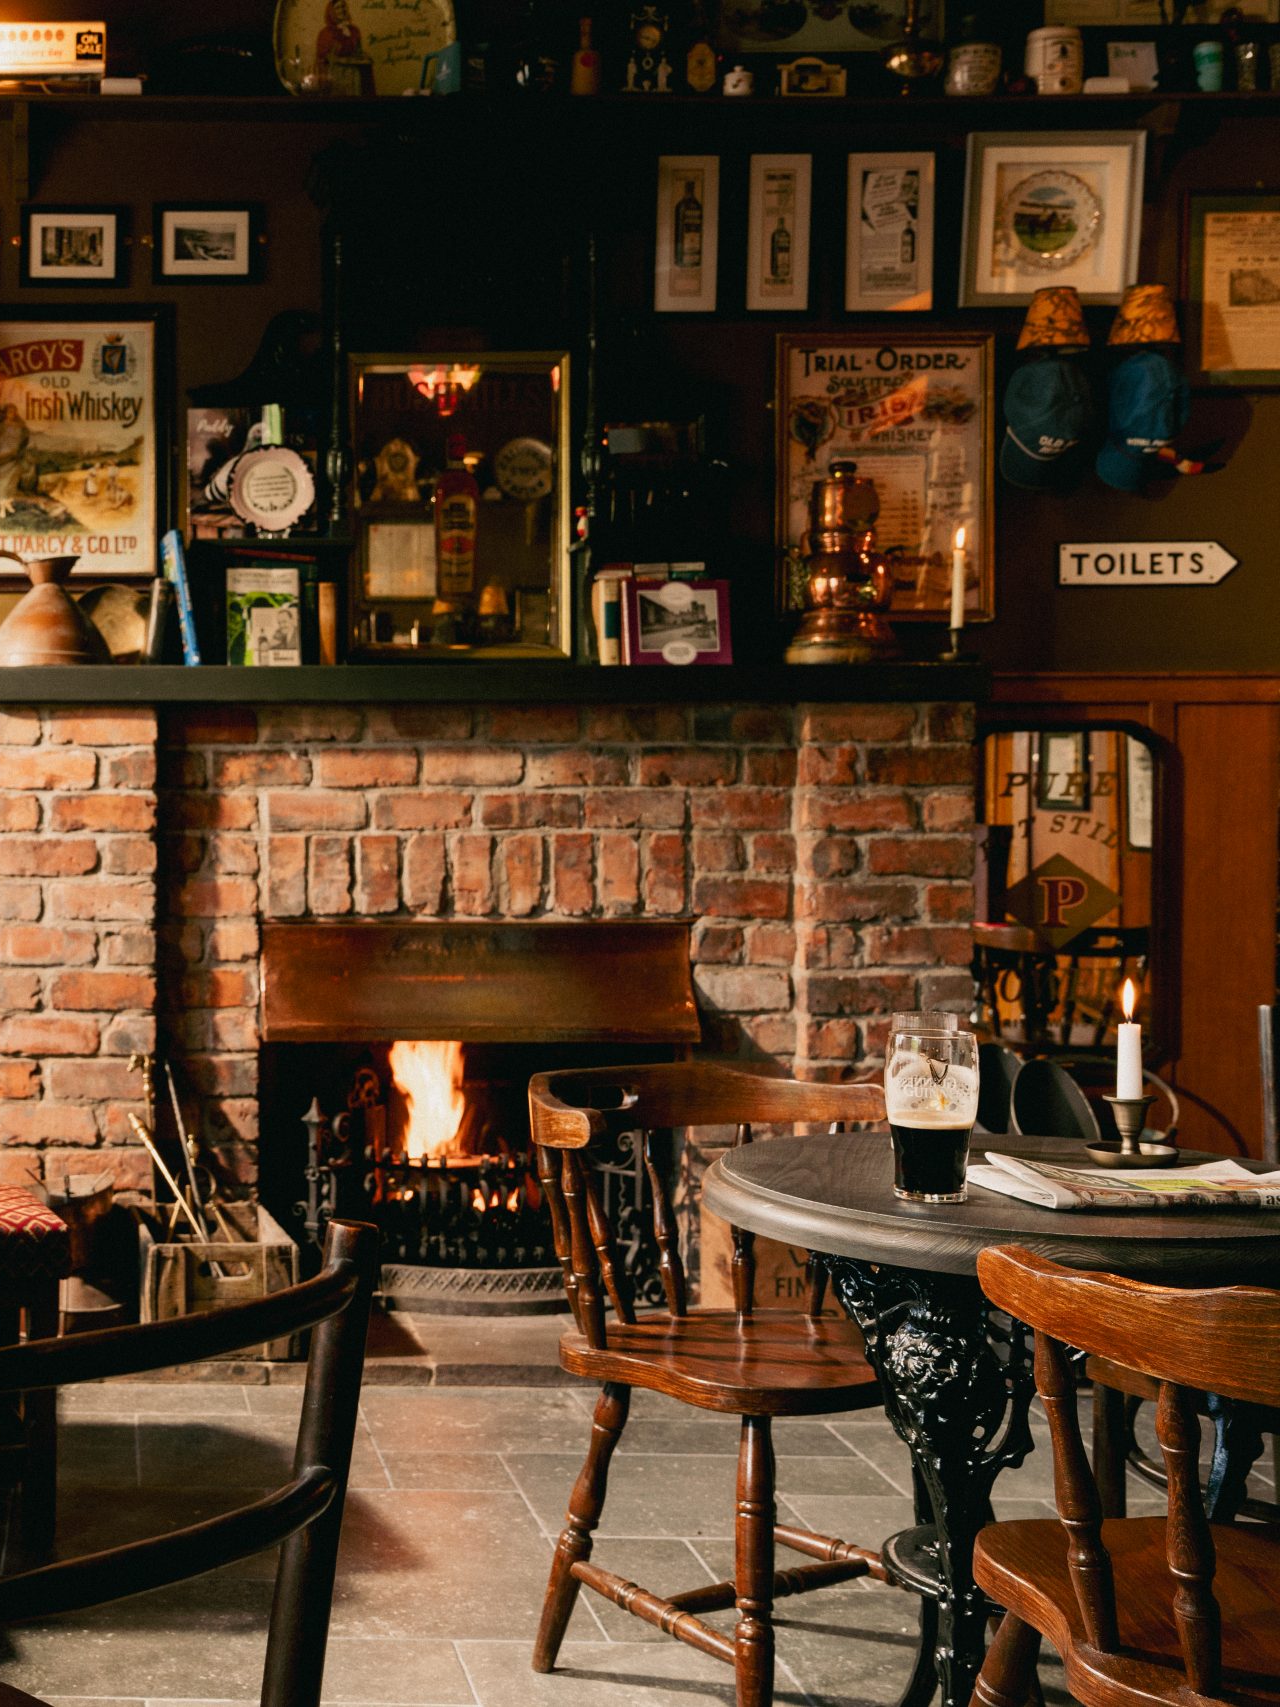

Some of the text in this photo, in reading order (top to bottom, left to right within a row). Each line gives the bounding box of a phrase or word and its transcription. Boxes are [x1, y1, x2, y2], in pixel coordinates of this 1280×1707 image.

[81, 34, 98, 45] ON
[799, 345, 968, 378] TRIAL ORDER
[40, 376, 71, 389] OLD
[25, 391, 143, 429] Irish Whiskey
[71, 537, 82, 554] &
[1070, 552, 1204, 576] TOILETS
[1037, 875, 1088, 930] P
